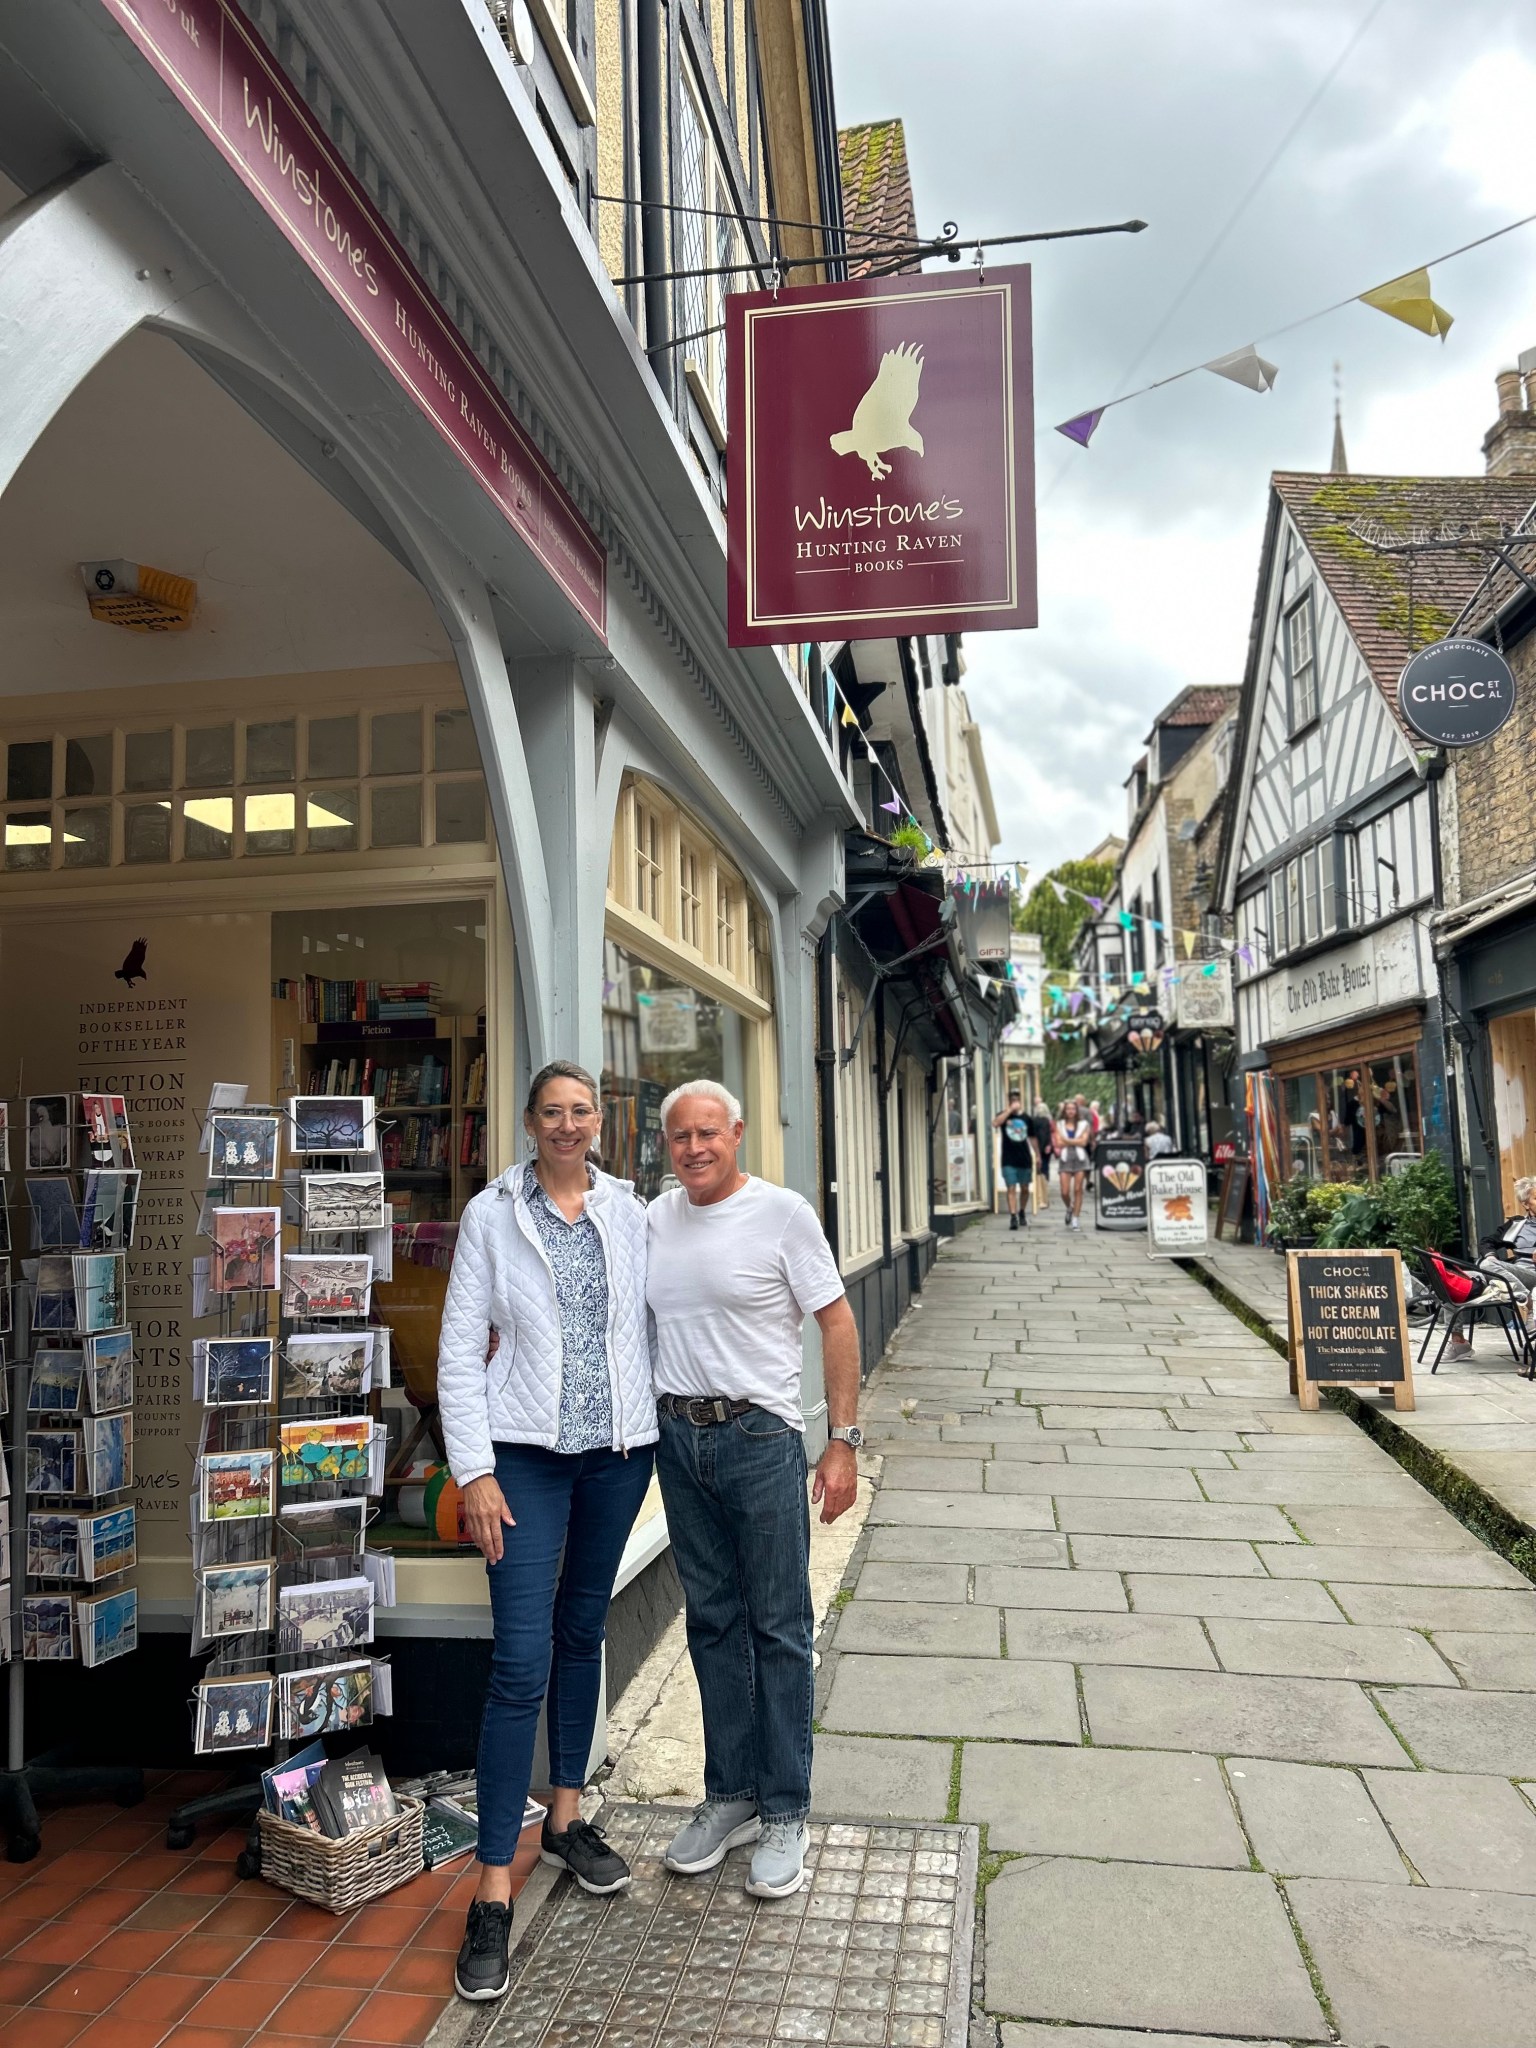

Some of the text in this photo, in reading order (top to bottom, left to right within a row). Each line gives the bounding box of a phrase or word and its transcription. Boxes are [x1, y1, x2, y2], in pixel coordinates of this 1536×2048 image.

[243, 76, 379, 296] Winstone's
[394, 298, 532, 508] HUNTING RAVEN BOOKS
[794, 493, 964, 531] Winstone's
[796, 534, 963, 559] HUNTING RAVEN
[854, 560, 904, 573] BOOKS
[109, 615, 184, 626] Modern
[1423, 644, 1489, 660] FINE CHOCOLATE
[1411, 680, 1500, 703] CHOC ET
[1488, 690, 1503, 699] AL
[1441, 730, 1479, 740] EST. 2019
[979, 948, 1005, 956] GIFTS
[1287, 962, 1371, 1016] The Old Bake House
[79, 998, 188, 1015] INDEPENDENT
[79, 1018, 187, 1034] BOOKSELLER
[361, 1025, 392, 1035] Fiction
[78, 1036, 187, 1054] OF THE YEAR
[78, 1072, 185, 1093] FICTION
[148, 1119, 185, 1128] BOOKS
[153, 1134, 185, 1143] GIFTS
[142, 1150, 185, 1161] WRAP
[141, 1169, 185, 1180] CHERS
[1156, 1170, 1194, 1183] The Old
[1151, 1183, 1203, 1195] Bake House
[147, 1197, 183, 1208] OVER
[139, 1234, 184, 1251] DAY
[1323, 1266, 1362, 1277] CHOC
[132, 1284, 183, 1296] STORE
[1308, 1284, 1389, 1300] THICK SHAKES
[1320, 1305, 1381, 1320] ICE CREAM
[1307, 1326, 1397, 1340] HOT CHOCOLATE
[1316, 1345, 1330, 1353] The
[1330, 1345, 1345, 1353] best
[1345, 1345, 1366, 1355] things
[136, 1375, 180, 1388] LUBS
[136, 1394, 181, 1406] FAIRS
[134, 1427, 181, 1436] SUPPORT
[136, 1497, 179, 1510] RAVEN
[425, 1839, 454, 1853] 2023
